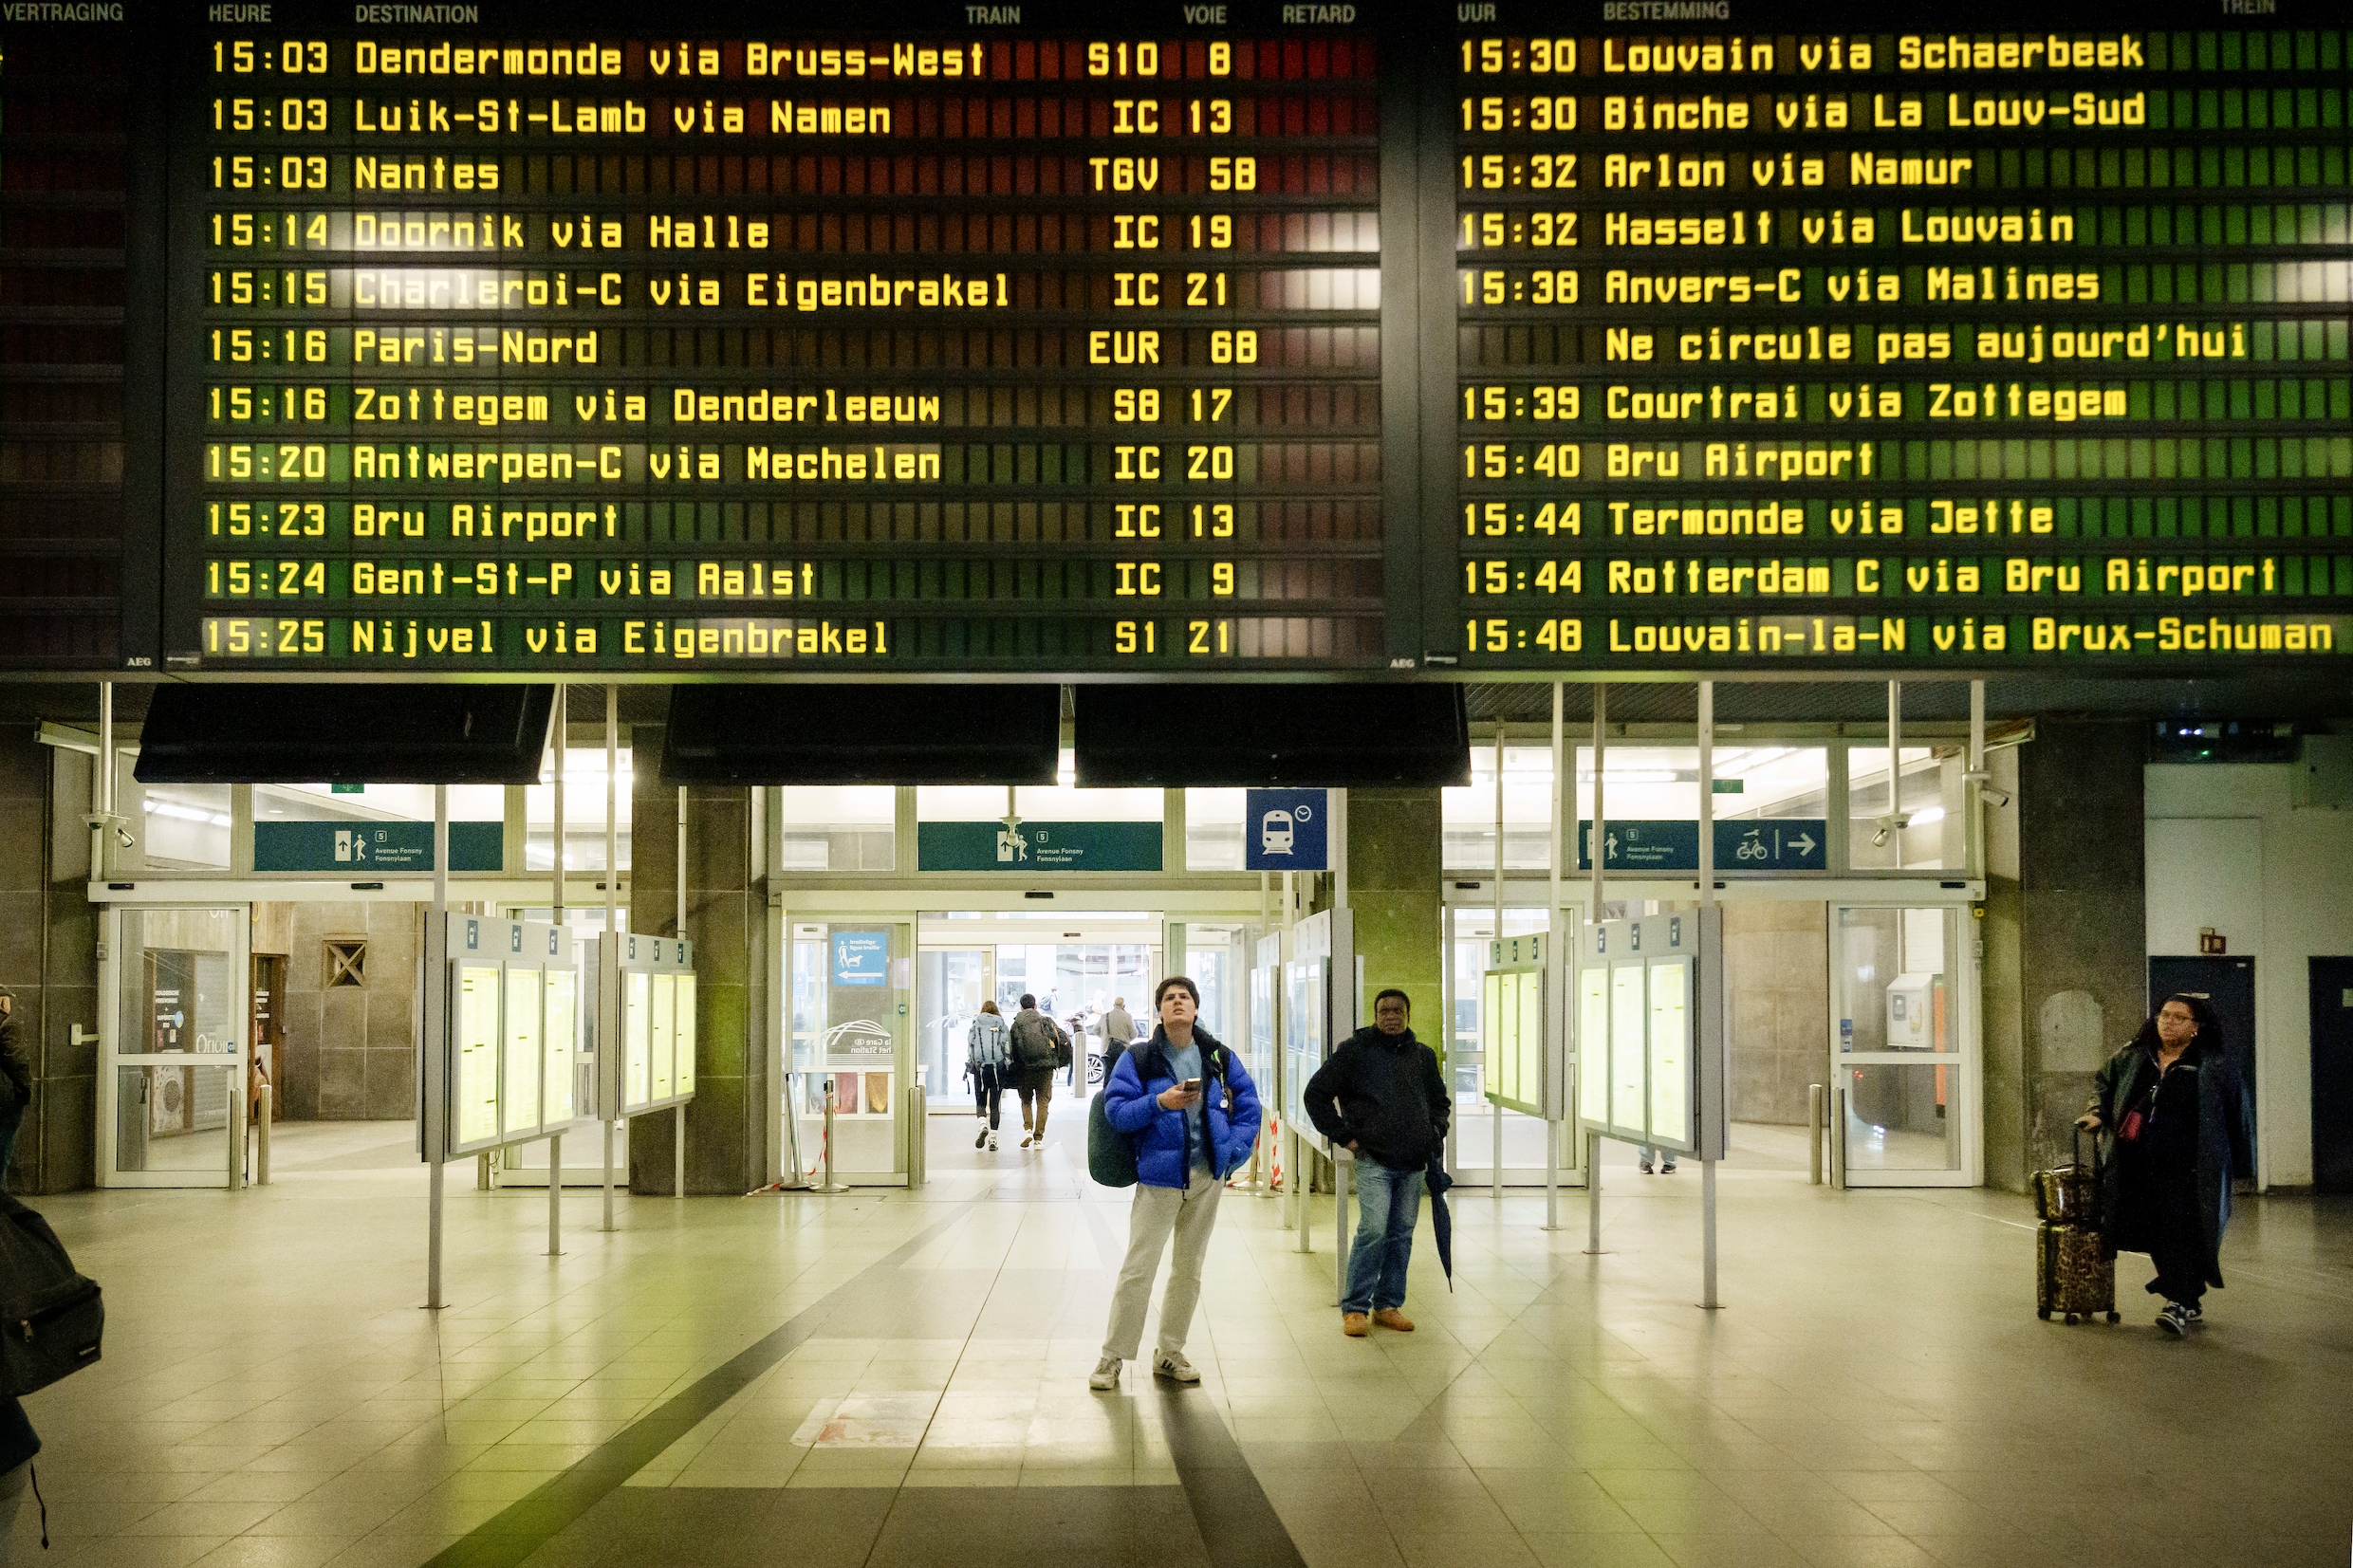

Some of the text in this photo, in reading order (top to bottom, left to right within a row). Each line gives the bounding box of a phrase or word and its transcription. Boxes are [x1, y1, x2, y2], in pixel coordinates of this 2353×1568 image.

[3, 4, 123, 22] VERTRAGING
[209, 5, 1356, 25] HEURE DESTINATION TRAIN VOIE RETARD
[1457, 3, 1496, 23] UUR
[1603, 1, 1730, 20] BESTEMMING
[213, 41, 1231, 76] 15:03 Dendermonde via Bruss-West S10 8
[1462, 34, 2143, 73] 15:30 Louvain via Schaerbeek
[213, 99, 1232, 134] 15:03 Luik-St-Lamb via Namen IC 13
[1462, 92, 2145, 131] 15:30 Binche via La Louv-Sud
[213, 157, 327, 189] 15:03
[356, 157, 499, 190] Nantes
[1089, 157, 1158, 192] TGV
[1462, 152, 1973, 189] 15:32 Arlon via Namur
[213, 213, 1232, 249] 15:14 Doornik via Halle IC 19
[1462, 209, 2073, 247] 15:32 Hasselt via Louvain
[212, 271, 1226, 312] 15:15 Charleroi-C via Eigenbrakel IC 21
[1464, 267, 2099, 304] 15:38 Anvers-C via Malines
[212, 329, 1257, 364] 15:16 Paris-Nord EUR 6B
[1606, 323, 2245, 364] Ne circule pas aujourd'hui
[211, 387, 1232, 426] 15:16 Zottegem via Denderleeuw S8 17
[1464, 383, 2126, 422] 15:39 Courtrai via Zottegem
[210, 445, 1233, 484] 15:20 Antwerpen-C via Mechelen IC 20
[1464, 442, 1873, 482] 15:40 Bru Airport
[210, 504, 1233, 543] 15:23 Bru Airport IC 13
[1465, 500, 2053, 536] 15:44 Termonde via Jette
[210, 562, 1234, 596] 15:24 Gent-St-P via Aalst IC 9
[1466, 558, 2275, 597] 15:44 Rotterdam C via Bru Airport
[209, 619, 1228, 658] 15:25 Nijvel via Eigenbrakel S1 21
[1467, 618, 2332, 652] 15:48 Louvain-la-N via Brux-Schuman
[127, 657, 152, 667] AEG
